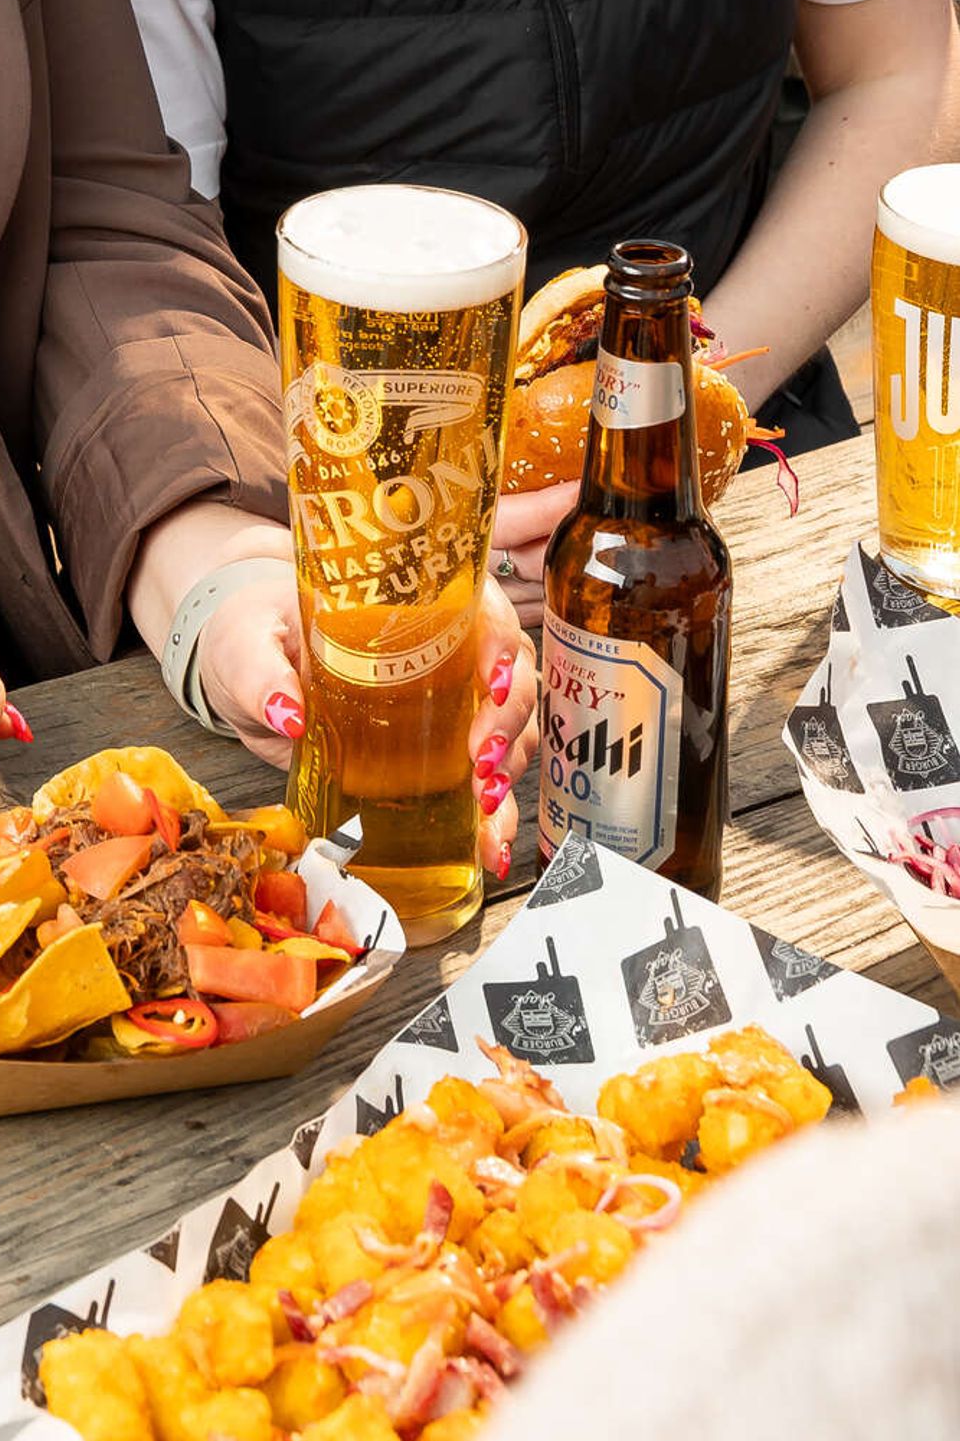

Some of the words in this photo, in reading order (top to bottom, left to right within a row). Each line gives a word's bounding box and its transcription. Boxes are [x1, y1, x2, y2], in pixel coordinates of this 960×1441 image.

[383, 381, 474, 396] SUPERIORE
[319, 463, 351, 480] DAL
[357, 450, 401, 473] 1846
[293, 424, 498, 551] ERONI
[321, 522, 458, 582] NASTRO
[588, 639, 620, 655] FREE
[556, 655, 596, 682] SUPER
[542, 868, 575, 888] BURGE
[521, 1037, 565, 1049] BURGER
